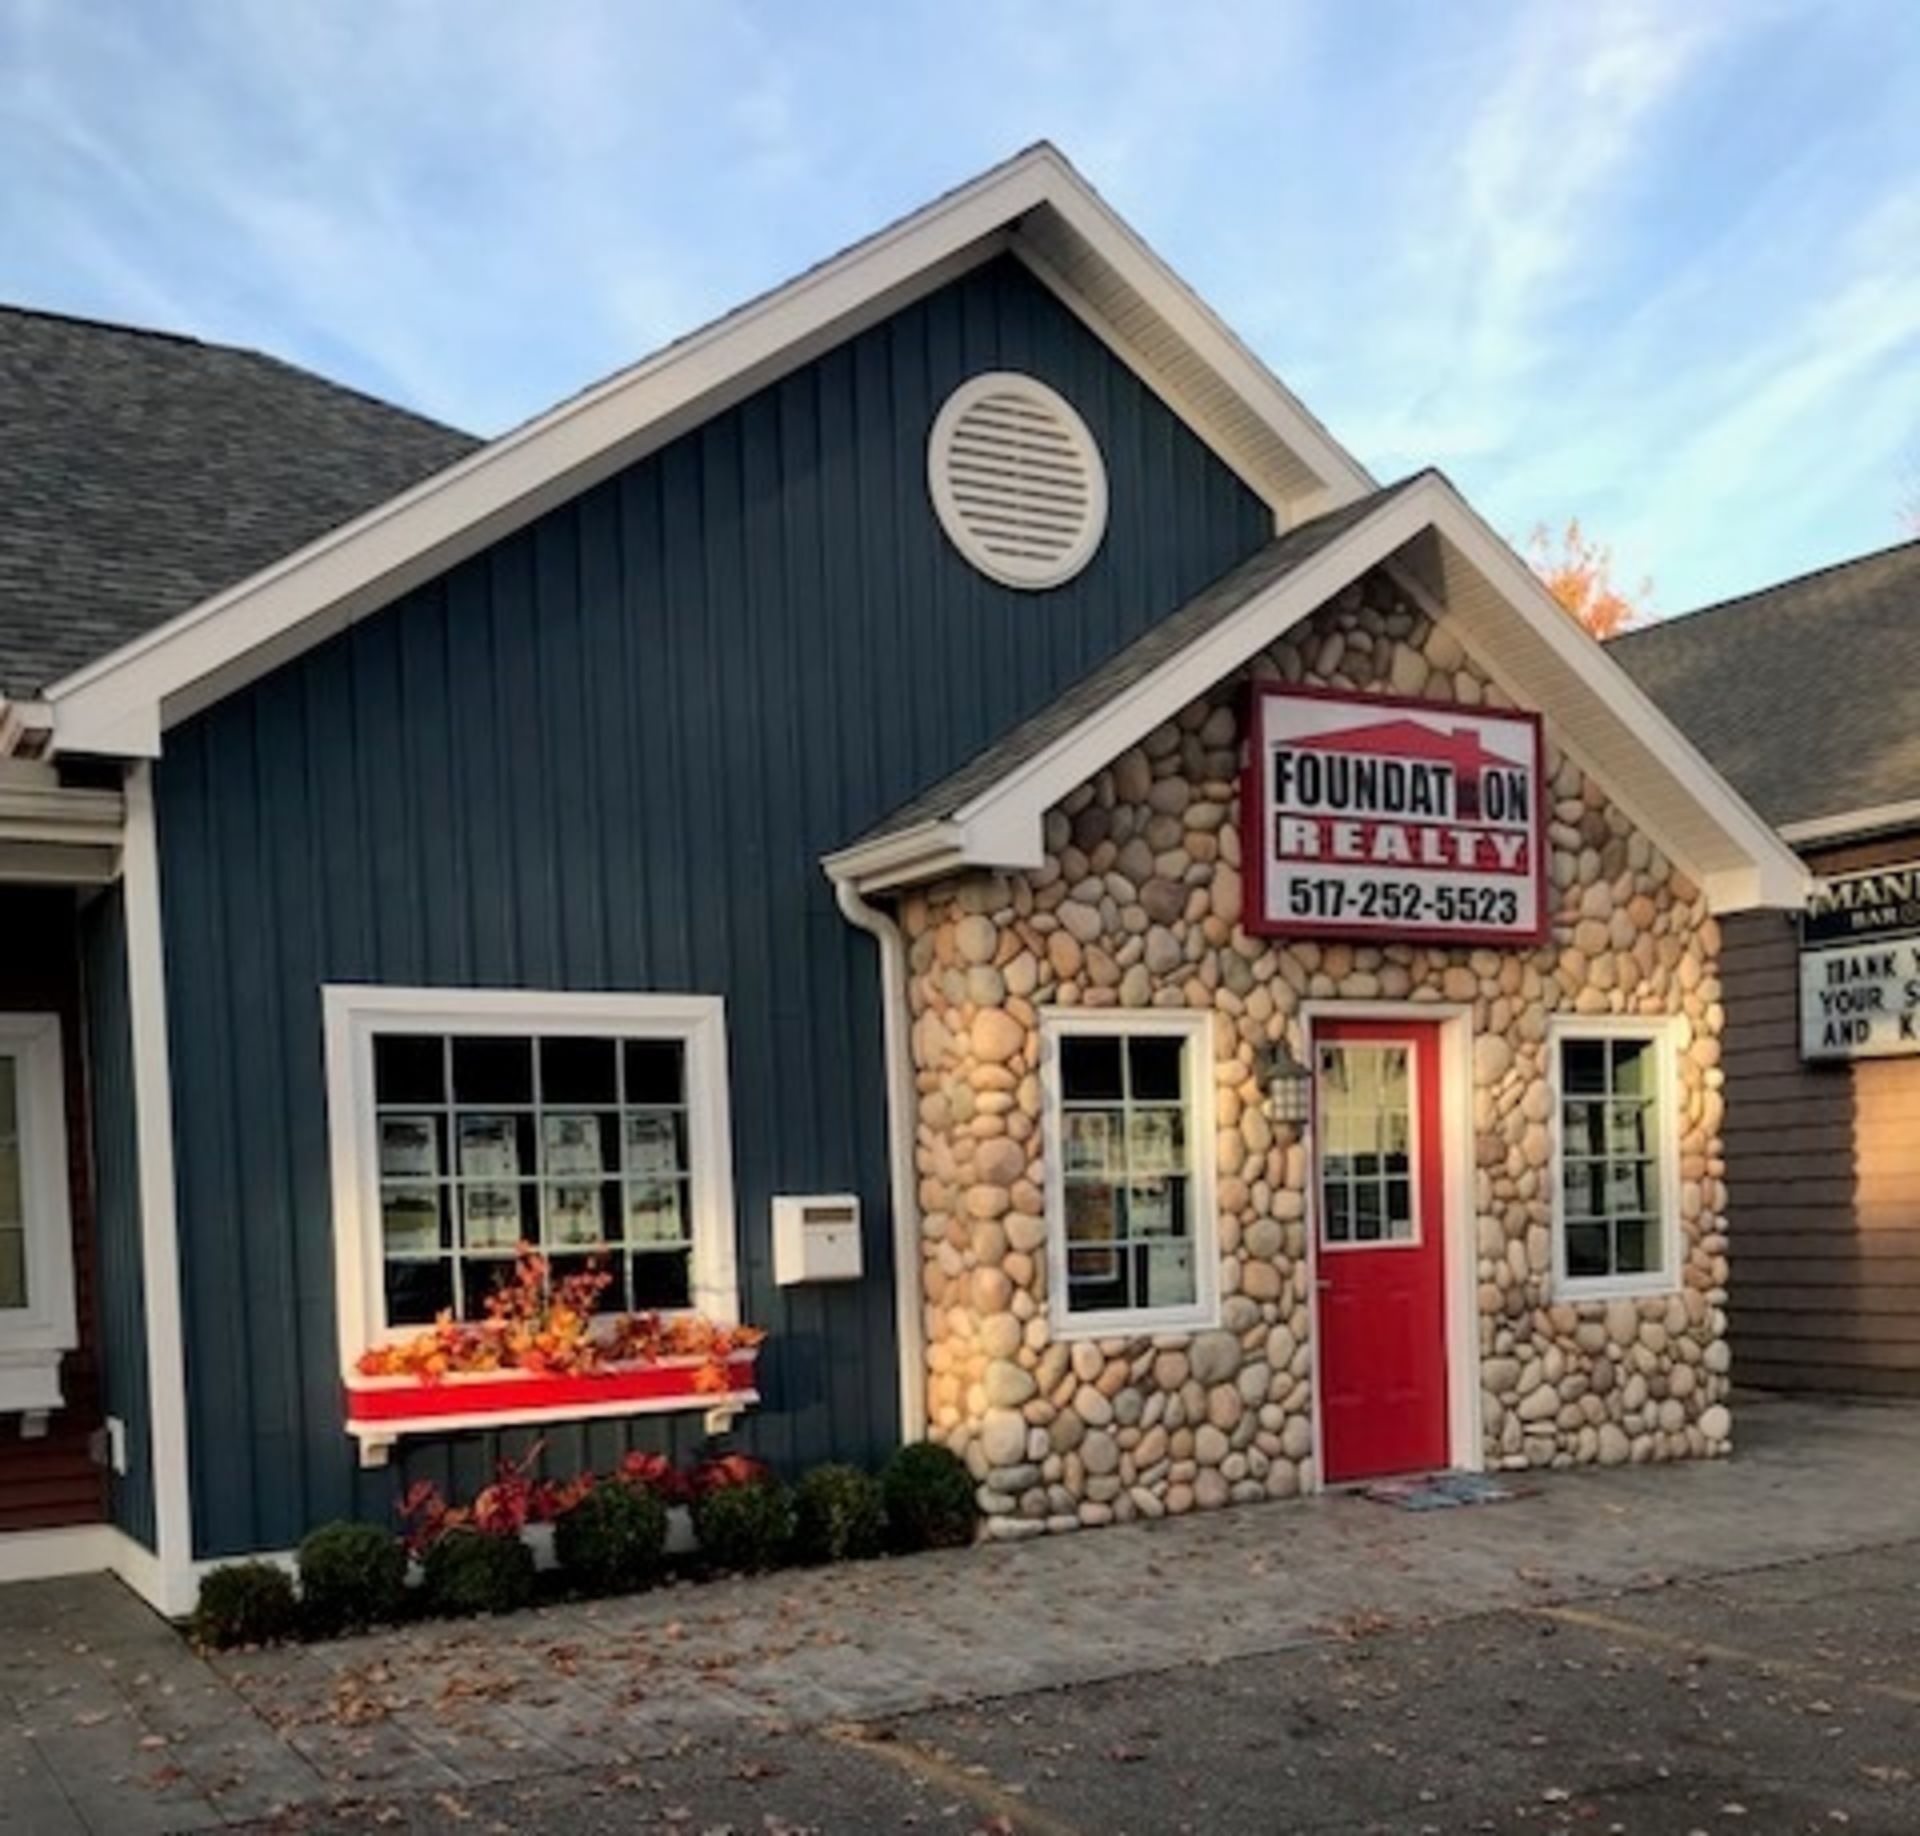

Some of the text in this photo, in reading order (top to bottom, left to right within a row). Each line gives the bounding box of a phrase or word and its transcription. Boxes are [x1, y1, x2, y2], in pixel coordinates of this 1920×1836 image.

[1279, 817, 1526, 869] REALTY
[1290, 878, 1518, 925] 517-252-5523
[1823, 1020, 1870, 1047] AND
